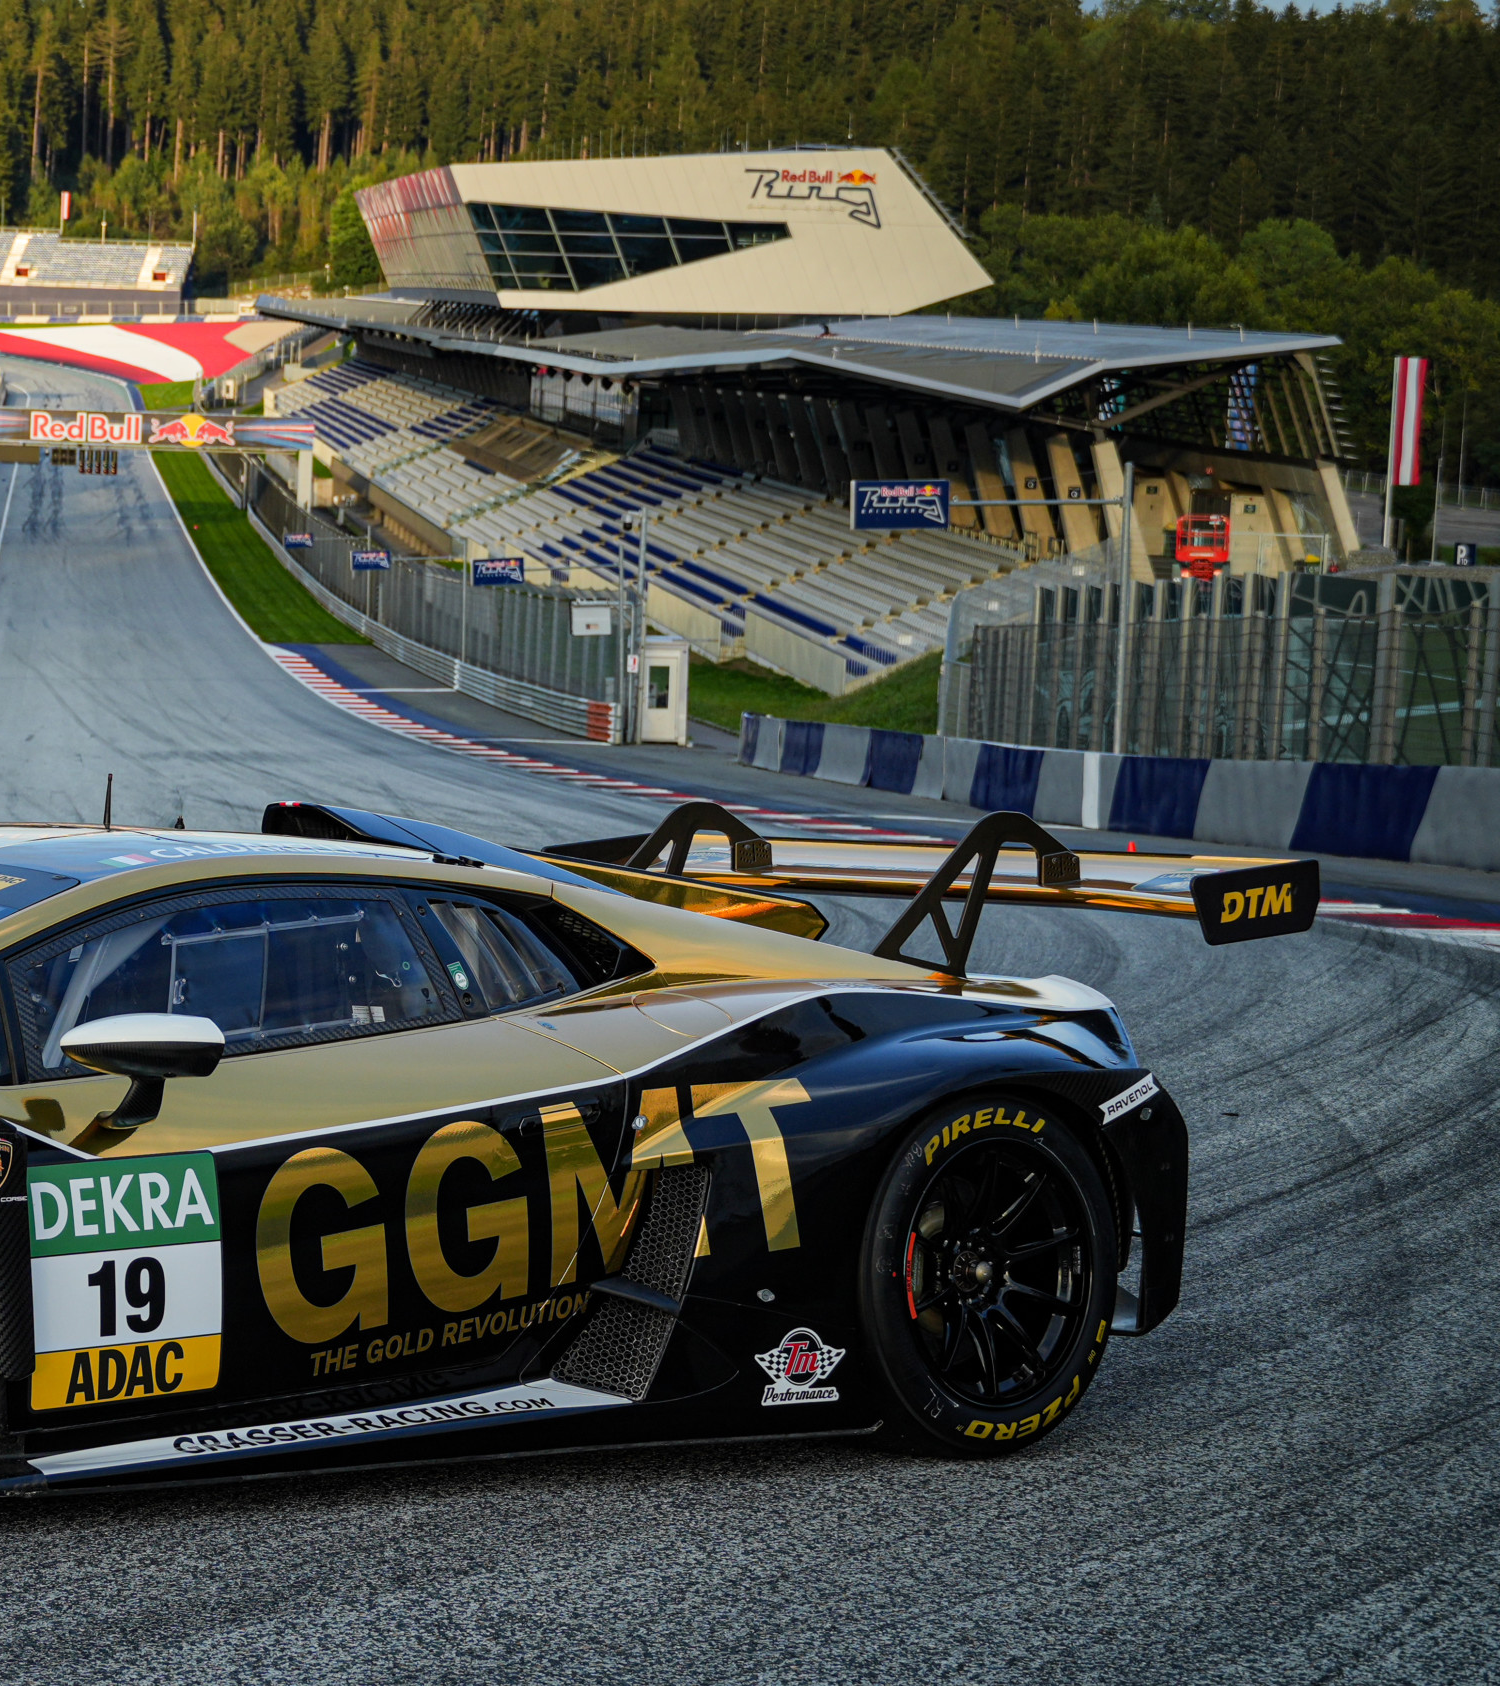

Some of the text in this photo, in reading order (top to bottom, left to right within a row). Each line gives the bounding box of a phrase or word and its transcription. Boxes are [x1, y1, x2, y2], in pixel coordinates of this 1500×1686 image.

[781, 170, 833, 184] Red Bull
[30, 411, 142, 444] Red Bull
[1456, 545, 1467, 565] P
[1220, 882, 1293, 924] DTM
[1107, 1083, 1153, 1115] RAVENOL
[923, 1107, 1046, 1166] PIRELLI
[30, 1167, 215, 1241] DEKRA
[255, 1077, 812, 1344] GGMT
[88, 1256, 166, 1337] 19
[310, 1291, 592, 1377] THE GOLD REVOLUTION
[65, 1341, 184, 1405] ADAC
[172, 1397, 556, 1455] GRASSER-RACING.COM
